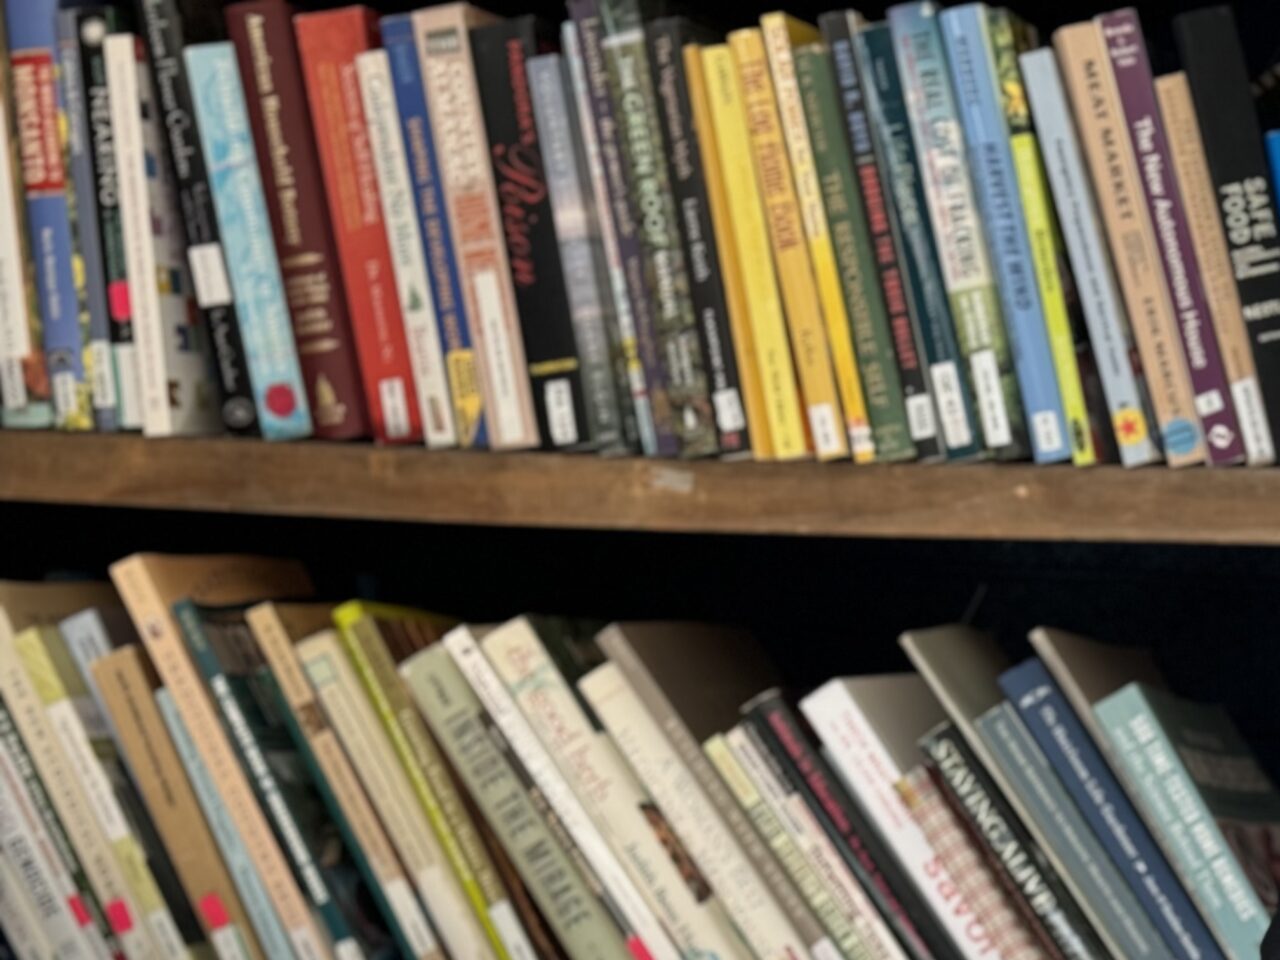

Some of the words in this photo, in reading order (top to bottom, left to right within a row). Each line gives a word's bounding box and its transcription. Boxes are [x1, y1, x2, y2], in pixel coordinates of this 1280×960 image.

[745, 56, 770, 95] The
[751, 97, 776, 133] Log
[1079, 57, 1110, 122] MEAT
[1096, 124, 1136, 222] MARKET
[1132, 114, 1159, 151] The
[623, 91, 652, 173] GREEN
[639, 176, 665, 248] ROOF
[821, 170, 846, 216] THE
[1141, 151, 1168, 190] New
[768, 201, 797, 252] Book
[1220, 182, 1247, 244] FOOD
[1244, 176, 1277, 242] SAFE
[1150, 190, 1198, 315] Autonomous
[1180, 317, 1211, 370] House
[528, 680, 581, 746] good
[442, 705, 508, 792] INSIDE
[491, 789, 537, 840] THE
[519, 836, 591, 931] MIRAGE
[928, 733, 1014, 848] STAYING
[997, 839, 1058, 916] ALIVE
